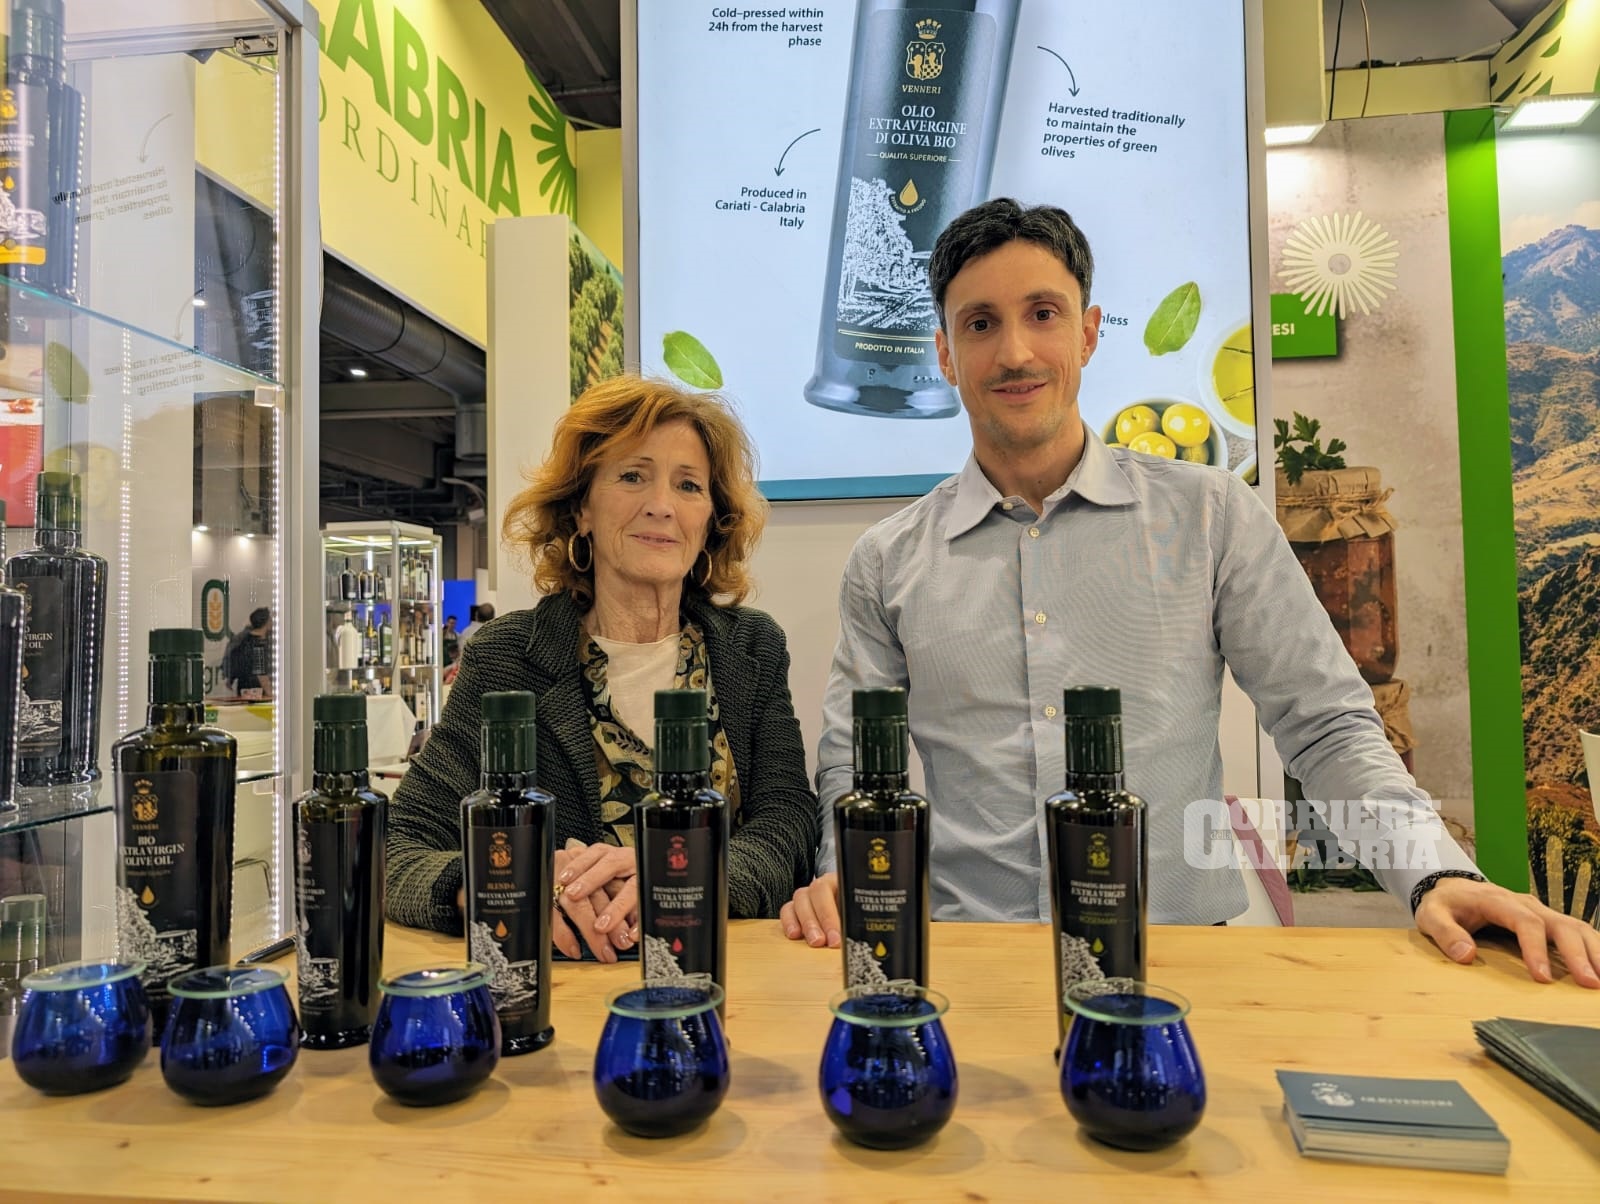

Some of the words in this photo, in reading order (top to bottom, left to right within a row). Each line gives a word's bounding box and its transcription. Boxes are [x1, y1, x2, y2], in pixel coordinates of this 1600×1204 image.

[788, 8, 824, 18] within
[708, 22, 729, 32] 24h
[731, 22, 758, 32] from
[760, 22, 779, 32] the
[781, 22, 823, 32] harvest
[788, 35, 822, 48] phase
[902, 84, 942, 95] VENNERI
[318, 0, 521, 217] ABRIA
[901, 105, 936, 118] OLIO
[1048, 102, 1109, 119] Harvested
[1111, 109, 1186, 129] traditionally
[868, 117, 968, 135] EXTRAVERGINE
[1046, 117, 1059, 128] to
[1061, 119, 1114, 134] maintain
[1117, 124, 1137, 136] the
[875, 132, 889, 144] DI
[891, 133, 931, 147] OLIVA
[933, 136, 956, 149] BIO
[1043, 132, 1105, 148] properties
[1107, 138, 1122, 149] of
[1122, 141, 1158, 153] green
[909, 153, 947, 163] SUPERIORE
[1041, 145, 1076, 159] olives
[741, 186, 794, 199] Produced
[796, 189, 807, 199] in
[715, 199, 751, 211] Cariati
[760, 201, 806, 213] Calabria
[779, 216, 804, 230] Italy
[854, 342, 893, 353] PRODOTTO
[903, 346, 925, 354] ITALIA
[138, 836, 155, 846] BIO
[147, 843, 185, 854] VIRGIN
[125, 856, 153, 866] OLIVE
[154, 855, 174, 865] OIL
[866, 922, 896, 931] LEMON
